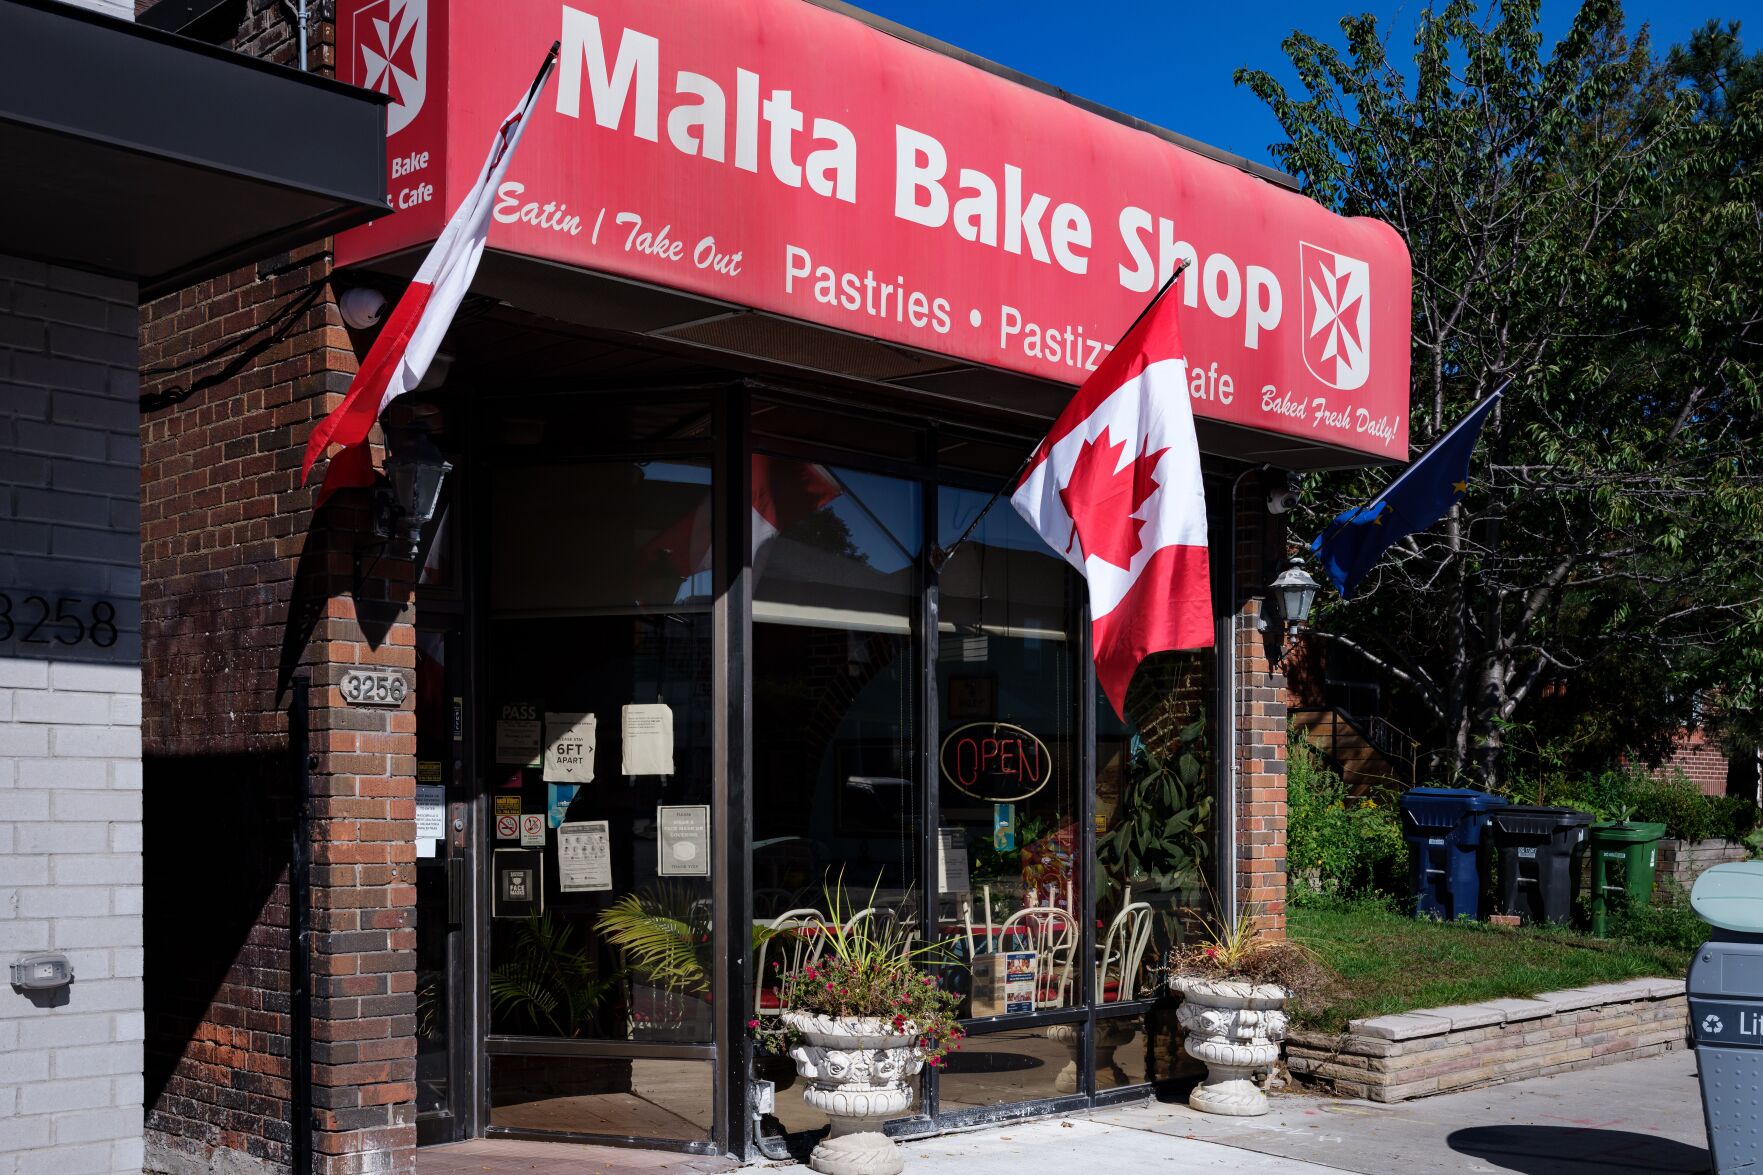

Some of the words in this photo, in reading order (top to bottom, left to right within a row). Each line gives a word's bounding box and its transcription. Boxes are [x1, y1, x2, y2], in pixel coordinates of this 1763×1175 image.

[391, 151, 430, 180] Bake
[556, 4, 857, 204] Malta
[894, 124, 1092, 275] Bake
[1118, 206, 1283, 350] Shop
[398, 182, 434, 210] Cafe
[492, 181, 563, 236] Eatin
[615, 211, 685, 262] Take
[693, 235, 743, 277] Out
[785, 243, 952, 335] Pastries
[1261, 384, 1308, 420] Baked
[1311, 397, 1352, 429] Fresh
[1355, 407, 1400, 447] Daily!
[348, 674, 404, 702] 3256
[502, 705, 537, 720] PASS
[556, 743, 583, 755] 6FT
[556, 756, 583, 764] APART
[957, 738, 1040, 786] OPEN
